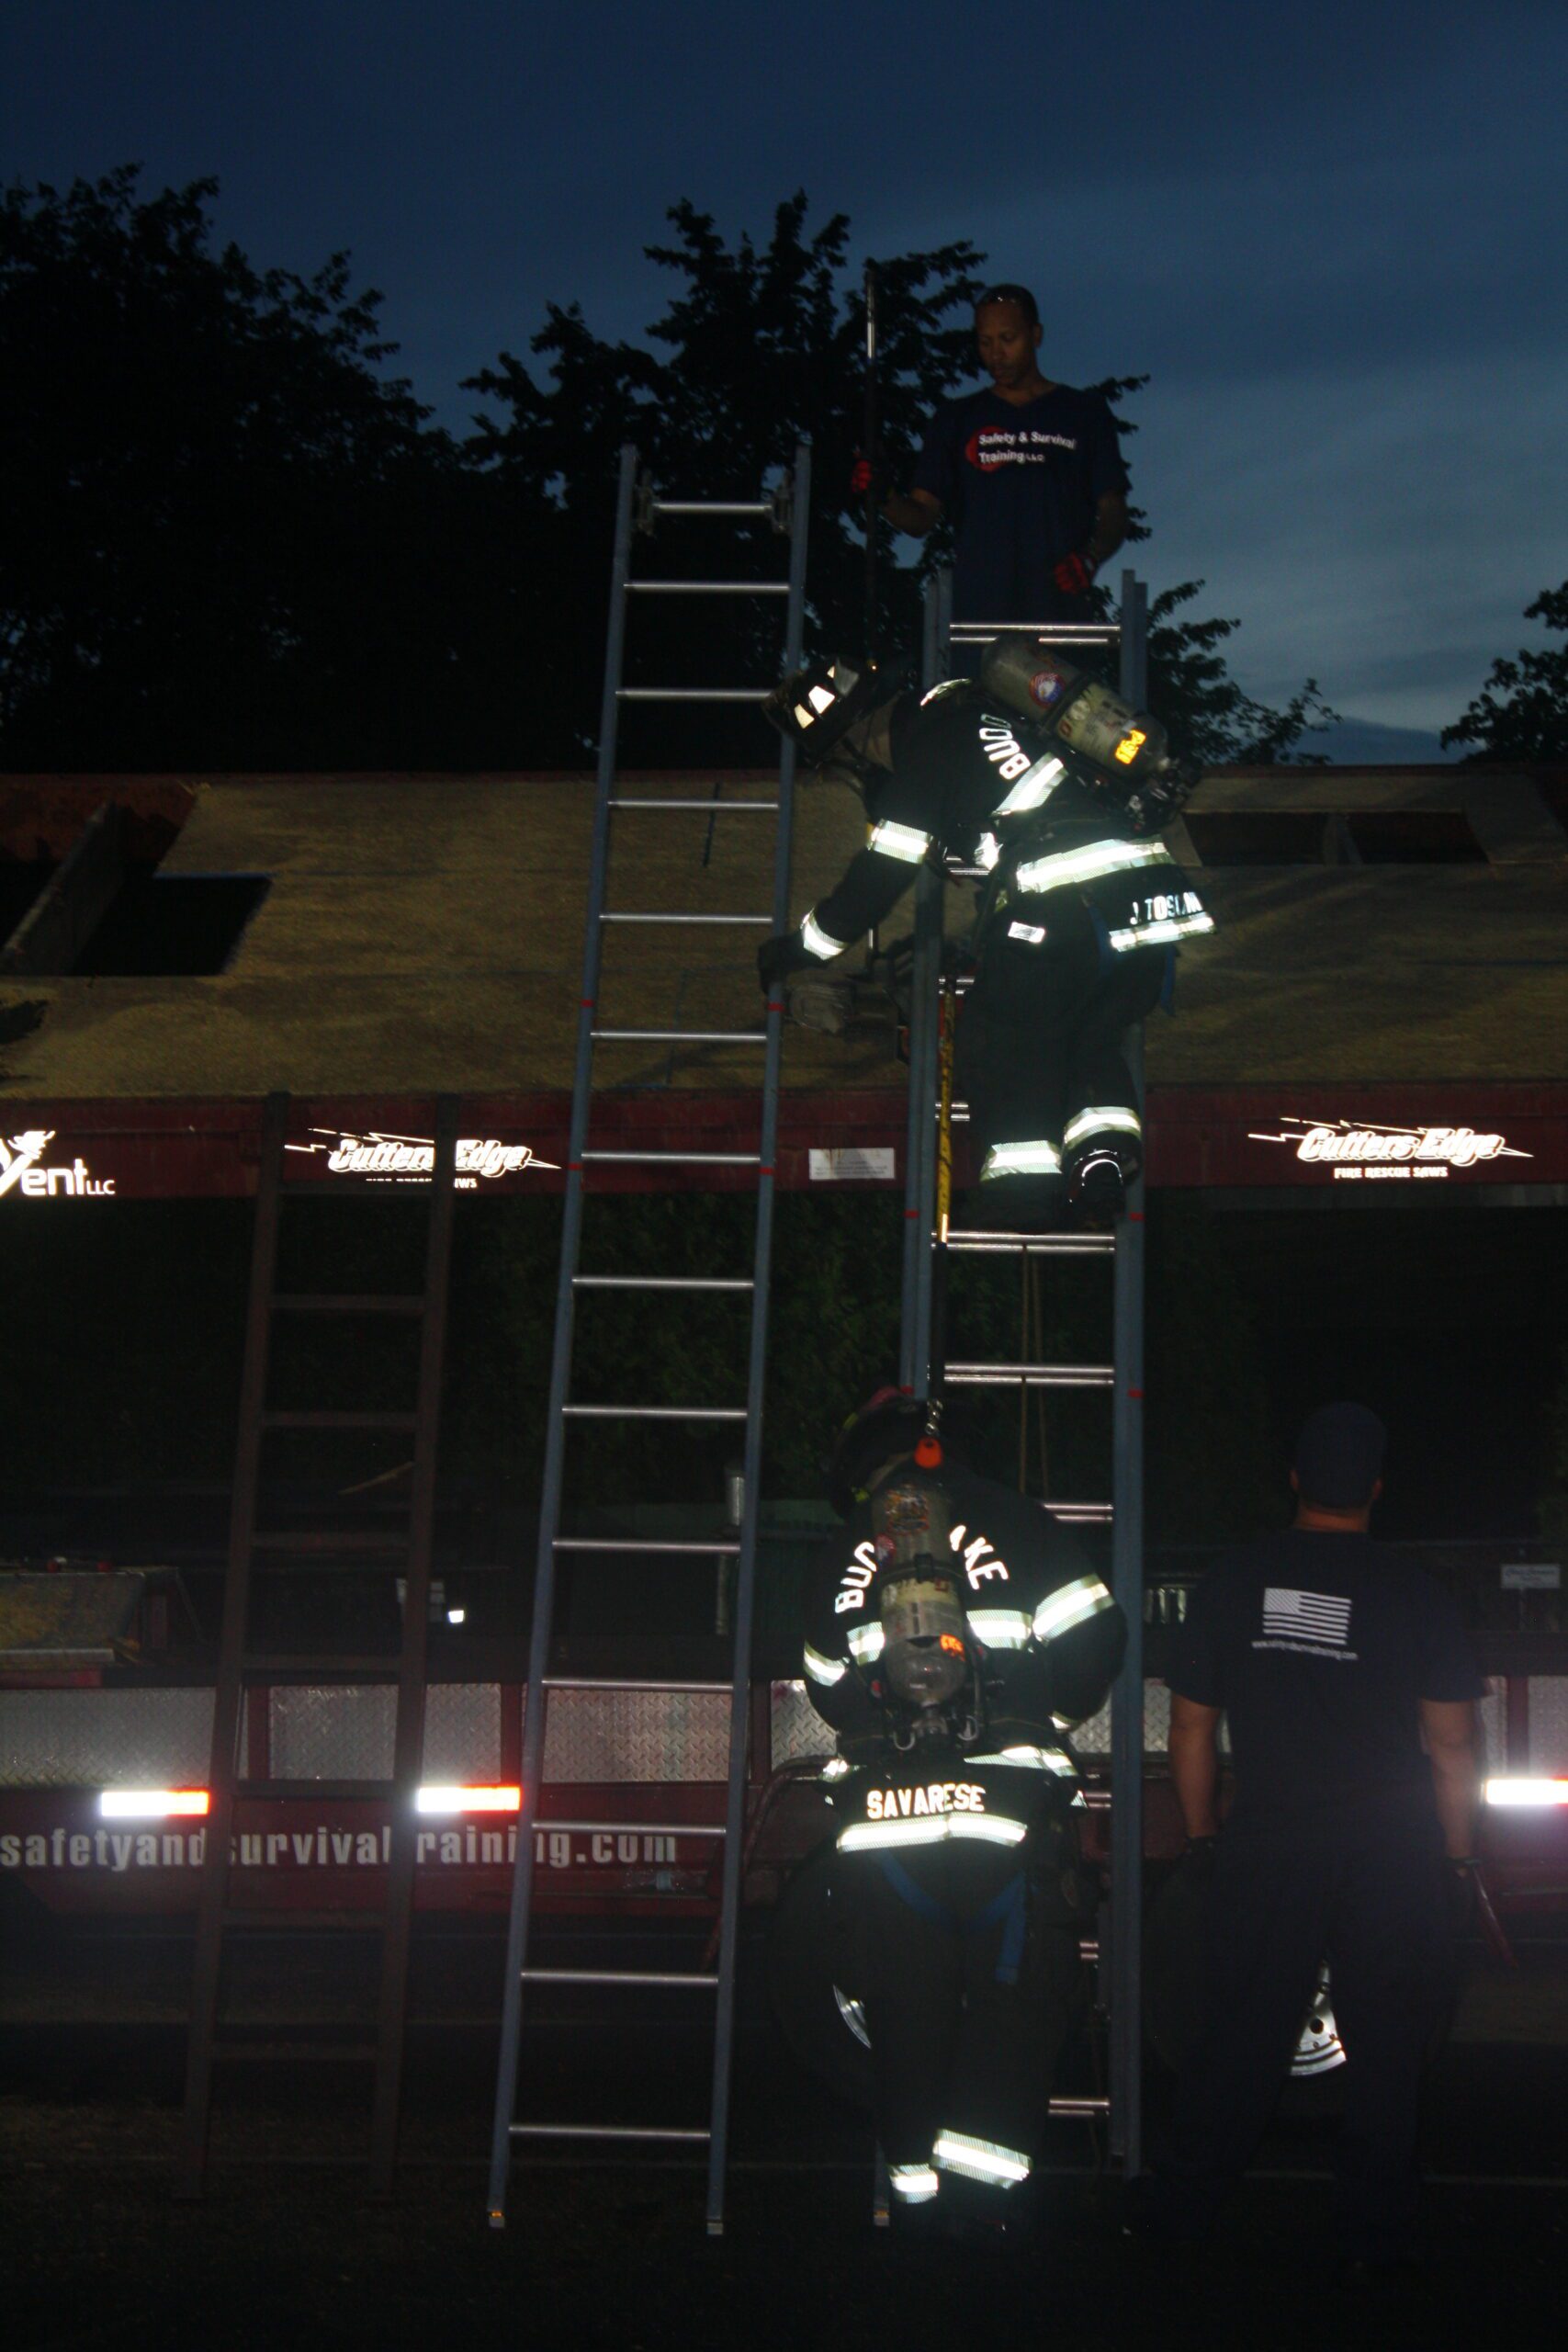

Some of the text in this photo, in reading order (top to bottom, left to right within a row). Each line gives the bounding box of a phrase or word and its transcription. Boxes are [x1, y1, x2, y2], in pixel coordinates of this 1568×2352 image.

[978, 431, 1077, 450] Safety & Survival
[978, 449, 1025, 464] Training
[455, 1139, 533, 1178] Edge
[1297, 1126, 1506, 1167] Cutters Edge
[1334, 1166, 1449, 1180] FIRE RESCUE SAWS
[866, 1782, 987, 1820] SAVARESE
